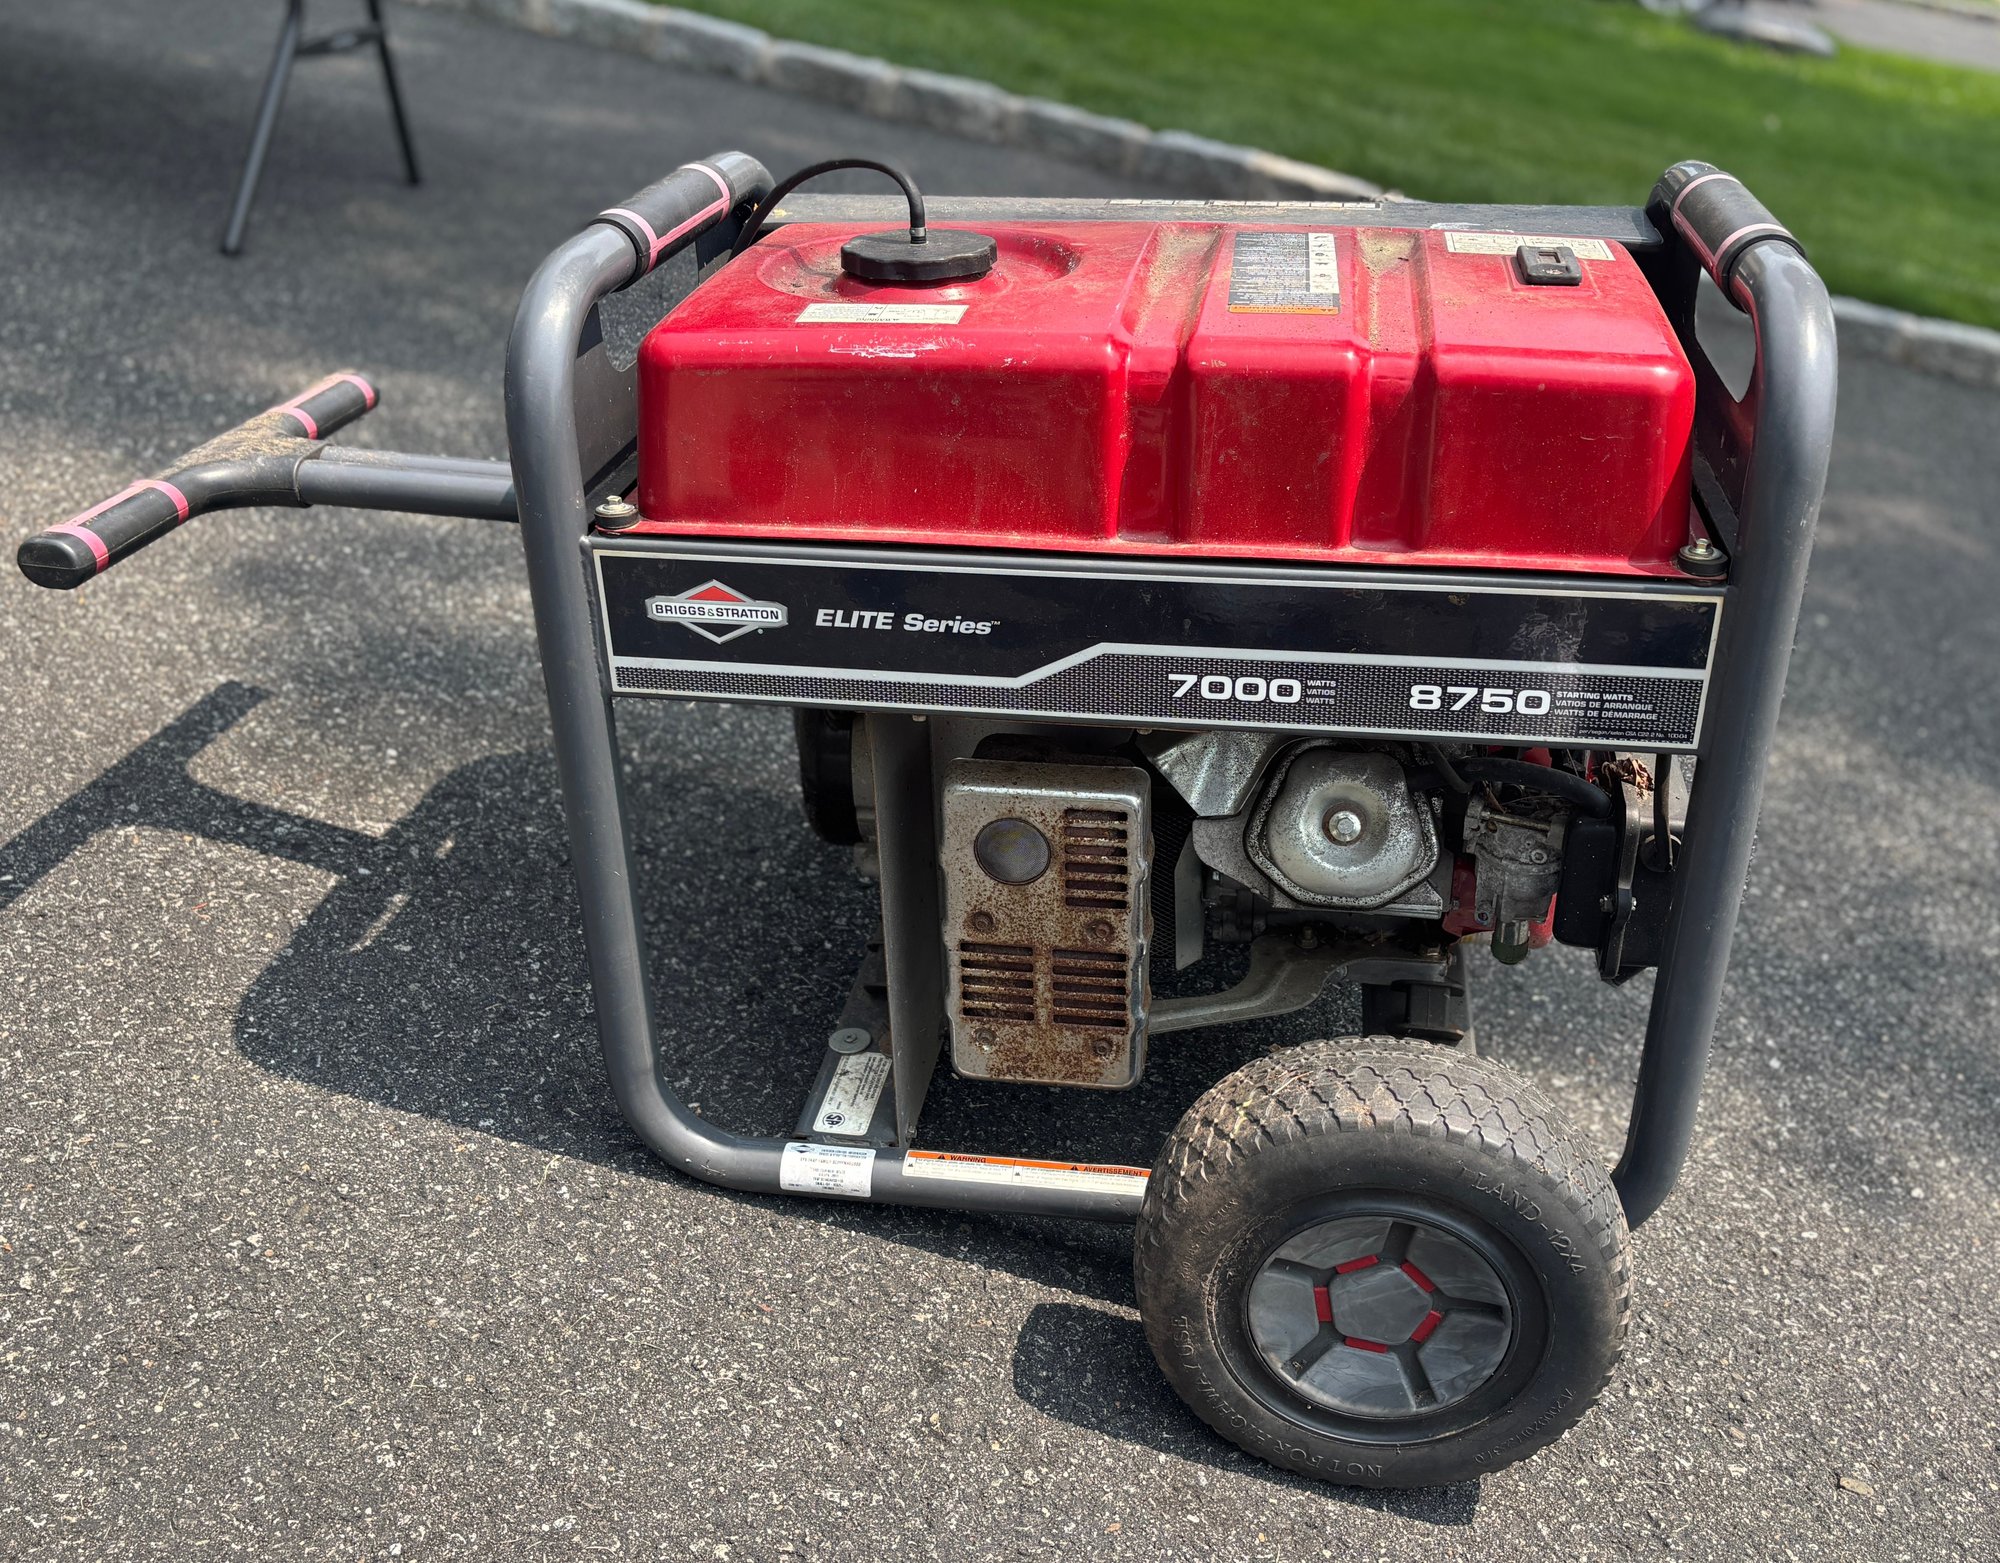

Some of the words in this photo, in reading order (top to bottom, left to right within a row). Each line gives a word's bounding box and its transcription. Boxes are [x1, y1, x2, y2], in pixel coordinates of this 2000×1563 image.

[815, 608, 895, 630] ELITE
[1168, 673, 1302, 704] 7000
[1306, 679, 1337, 688] WATTS
[1306, 688, 1336, 696] VATIOS
[1556, 691, 1600, 700] STARTING
[1602, 693, 1634, 701] WATTS
[1305, 697, 1335, 705] WATTS
[1409, 684, 1551, 715] 8750
[1555, 700, 1587, 708] VATIOS
[1603, 702, 1654, 711] ARRANQUE
[1554, 709, 1585, 717] WATTS
[1587, 710, 1599, 718] DE
[950, 1154, 987, 1164] WARNING
[1083, 1166, 1143, 1177] AVERTISSEMENT
